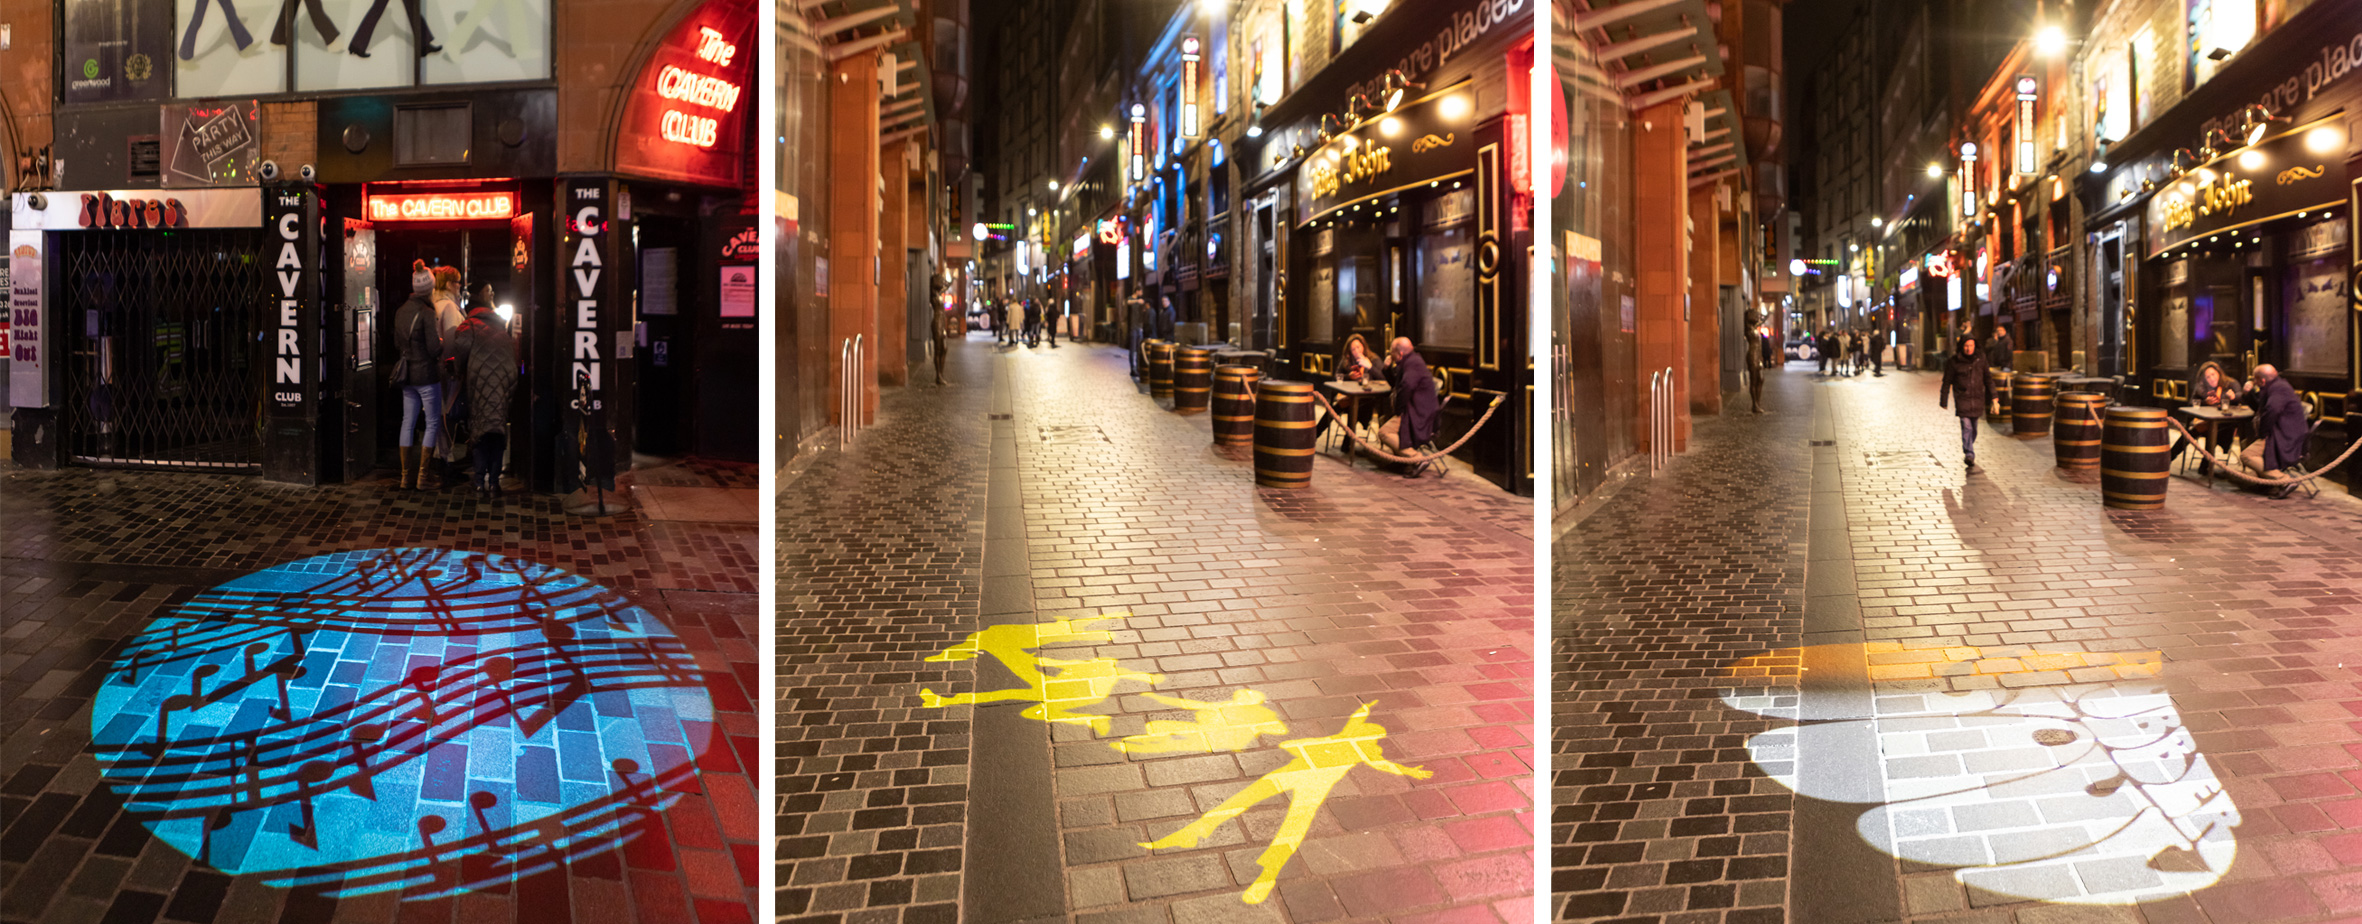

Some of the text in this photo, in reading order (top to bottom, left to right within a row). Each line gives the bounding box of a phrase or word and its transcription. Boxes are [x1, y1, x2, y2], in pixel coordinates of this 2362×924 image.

[698, 26, 736, 67] The
[656, 64, 741, 113] CAVERN
[1345, 69, 1400, 112] Ther
[1399, 41, 1432, 81] are
[193, 112, 238, 152] PARTY
[661, 109, 718, 148] CLUB
[2201, 101, 2257, 145] Ther
[201, 131, 243, 163] THIS WAY
[278, 196, 300, 206] THE
[369, 195, 511, 218] The CAVERN CLUB
[575, 188, 600, 199] THE
[721, 230, 759, 257] CAVE
[275, 212, 302, 384] CAVERN
[572, 206, 602, 390] CAVERN
[274, 391, 302, 402] CLUB
[570, 399, 602, 410] CB
